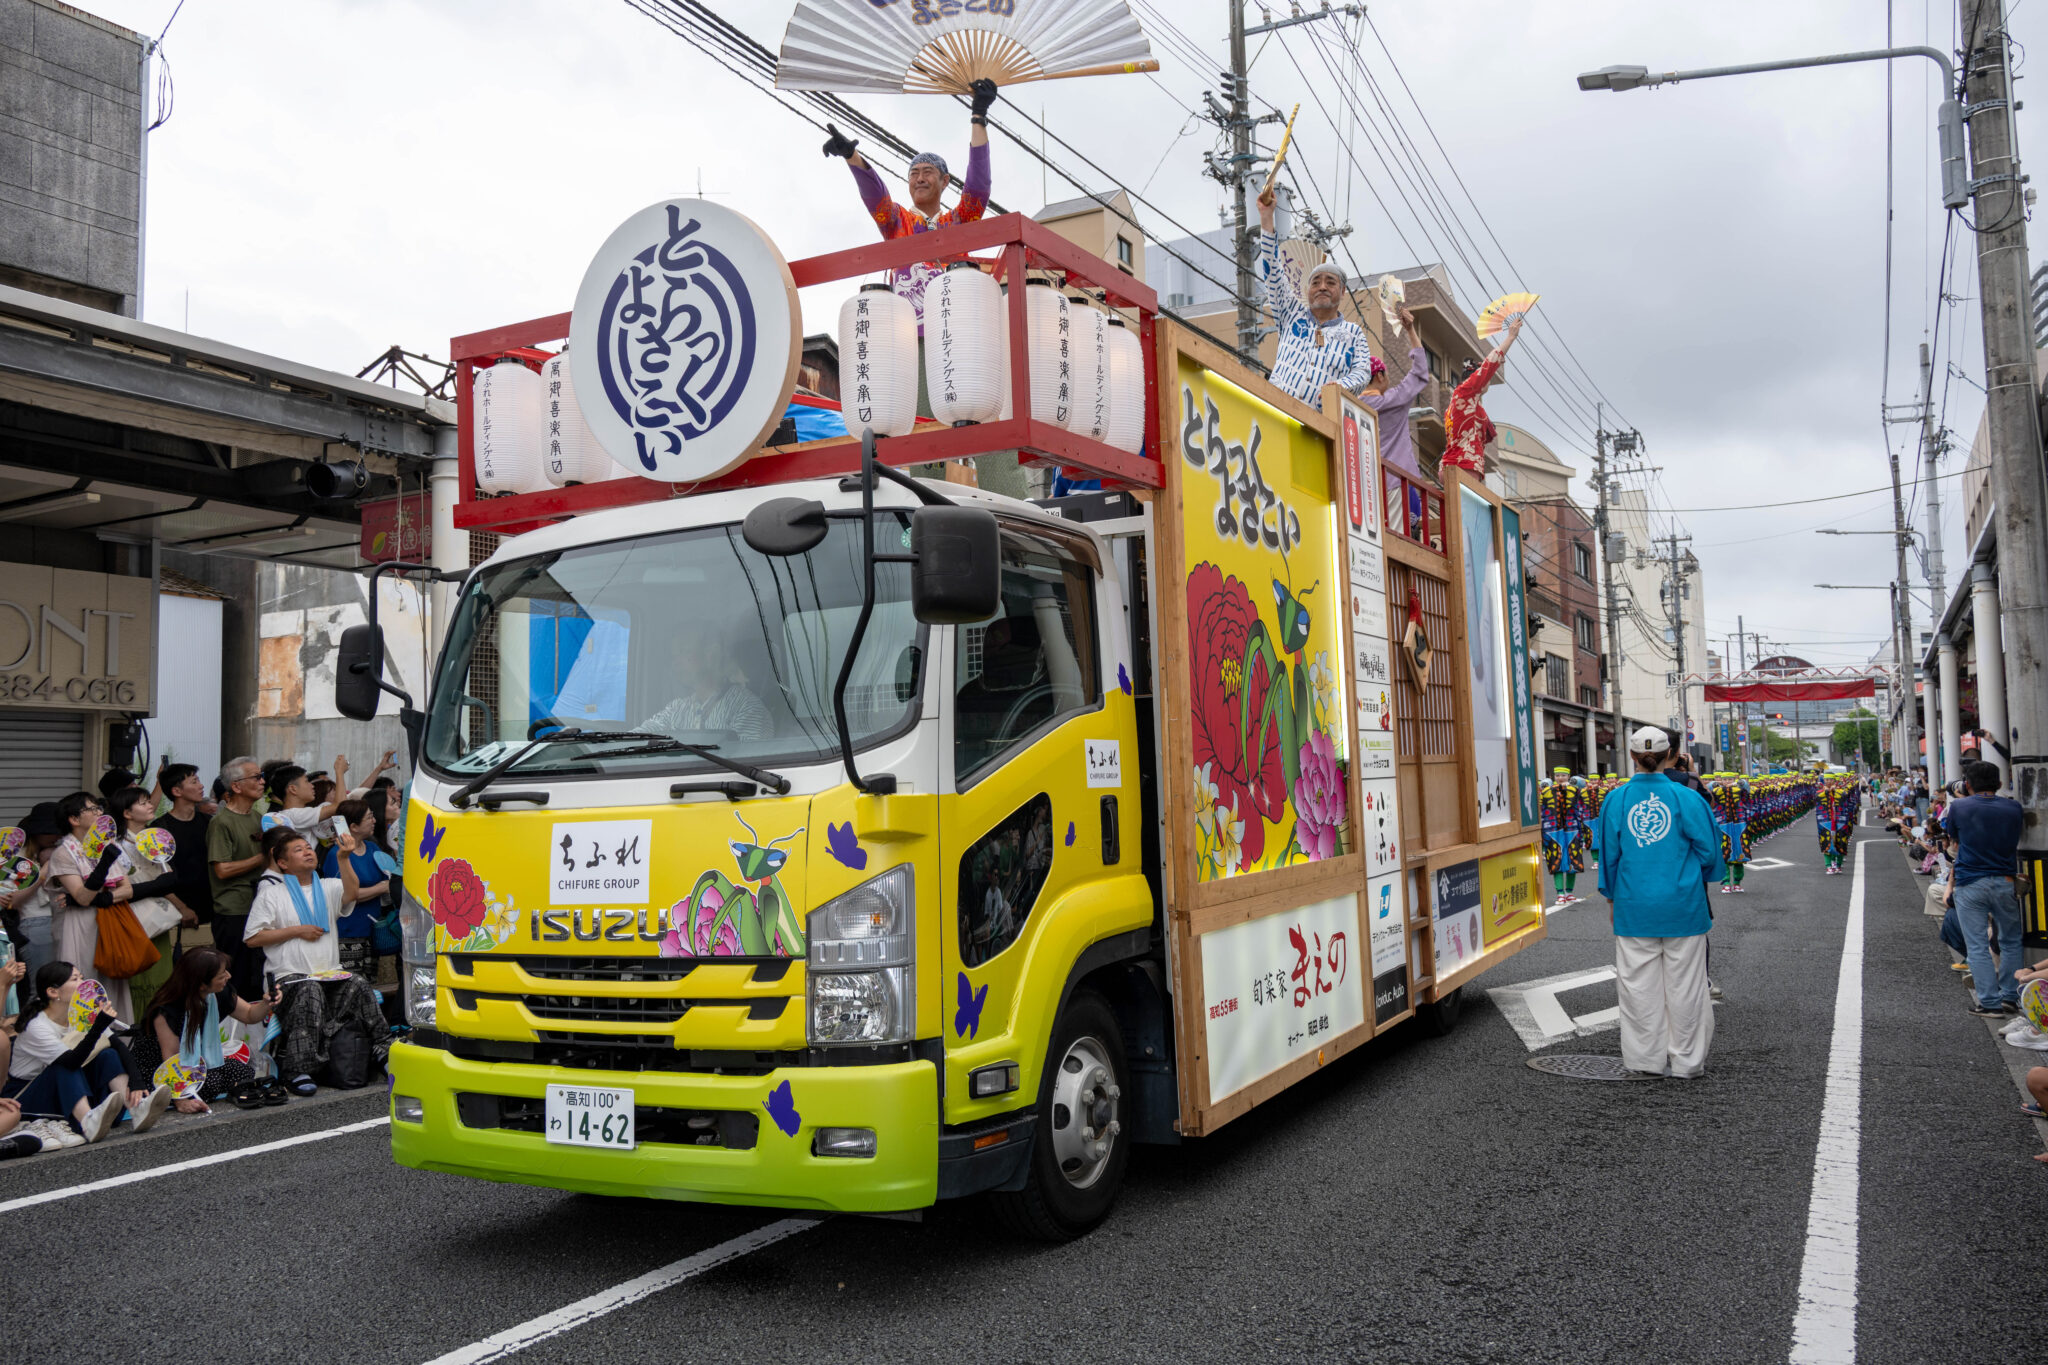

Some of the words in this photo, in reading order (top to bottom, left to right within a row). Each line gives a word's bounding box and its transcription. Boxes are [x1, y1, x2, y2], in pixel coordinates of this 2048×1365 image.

[559, 833, 642, 873] ちふれ
[558, 879, 600, 890] CHIFURE
[603, 878, 640, 889] GROUP
[531, 908, 668, 942] ISUZU
[1253, 968, 1288, 1007] 旬菜家
[1289, 923, 1347, 1008] まえの
[550, 1116, 562, 1130] わ
[567, 1110, 629, 1144] 14-62
